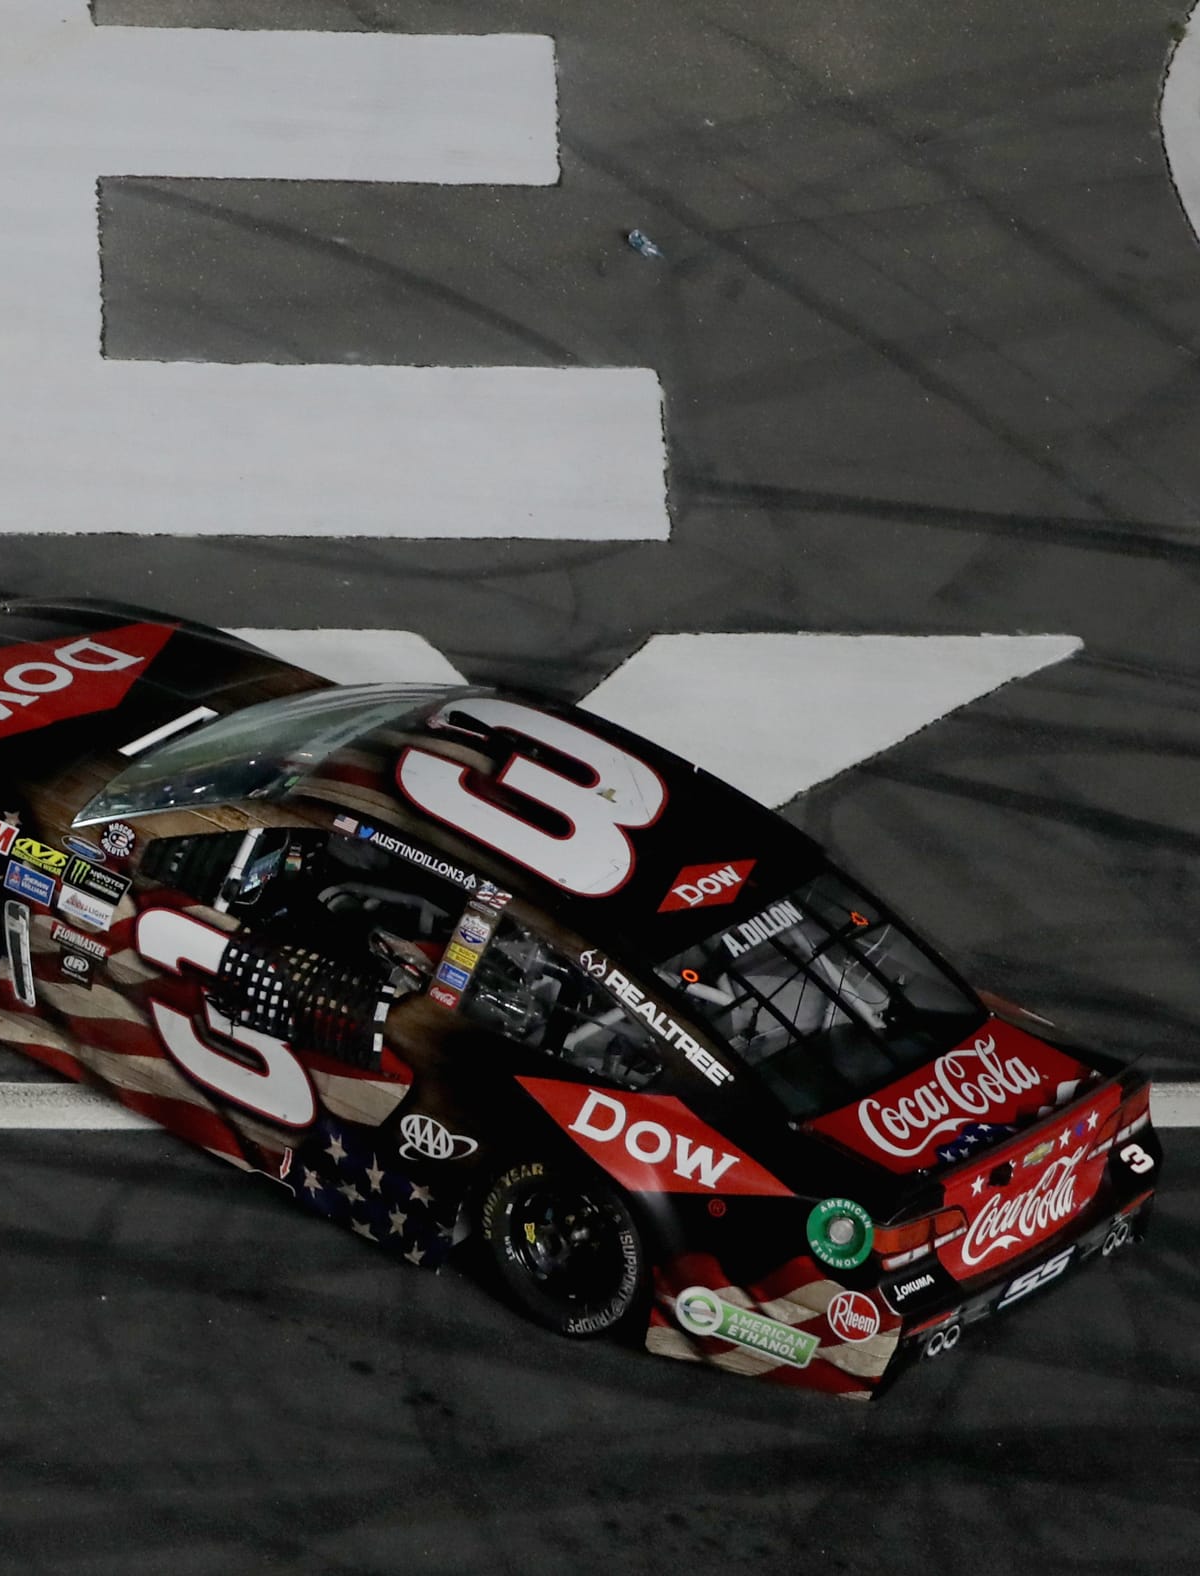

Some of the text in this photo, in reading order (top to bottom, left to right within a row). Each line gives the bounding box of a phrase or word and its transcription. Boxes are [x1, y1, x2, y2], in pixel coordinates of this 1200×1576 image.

[397, 699, 668, 898] 3
[101, 837, 131, 857] SALUTES
[109, 822, 136, 841] NASCAR
[369, 831, 465, 883] AUSTINDILLON3
[672, 865, 742, 906] DOW
[88, 906, 110, 921] LIGHT
[721, 900, 804, 958] A.DILLON
[52, 925, 107, 958] FLOWMASTER
[604, 970, 730, 1086] REALTREE
[858, 1034, 1041, 1157] Coca-Cola
[402, 1117, 453, 1158] AAA
[569, 1089, 739, 1189] DOW
[1120, 1143, 1154, 1174] 3
[819, 1200, 872, 1229] AMERICAN
[961, 1144, 1089, 1266] Coca-Cola
[811, 1239, 859, 1268] ETHANOL
[728, 1313, 808, 1349] AMERICAN
[832, 1293, 876, 1334] Rheem
[727, 1326, 797, 1360] ETHANOL
